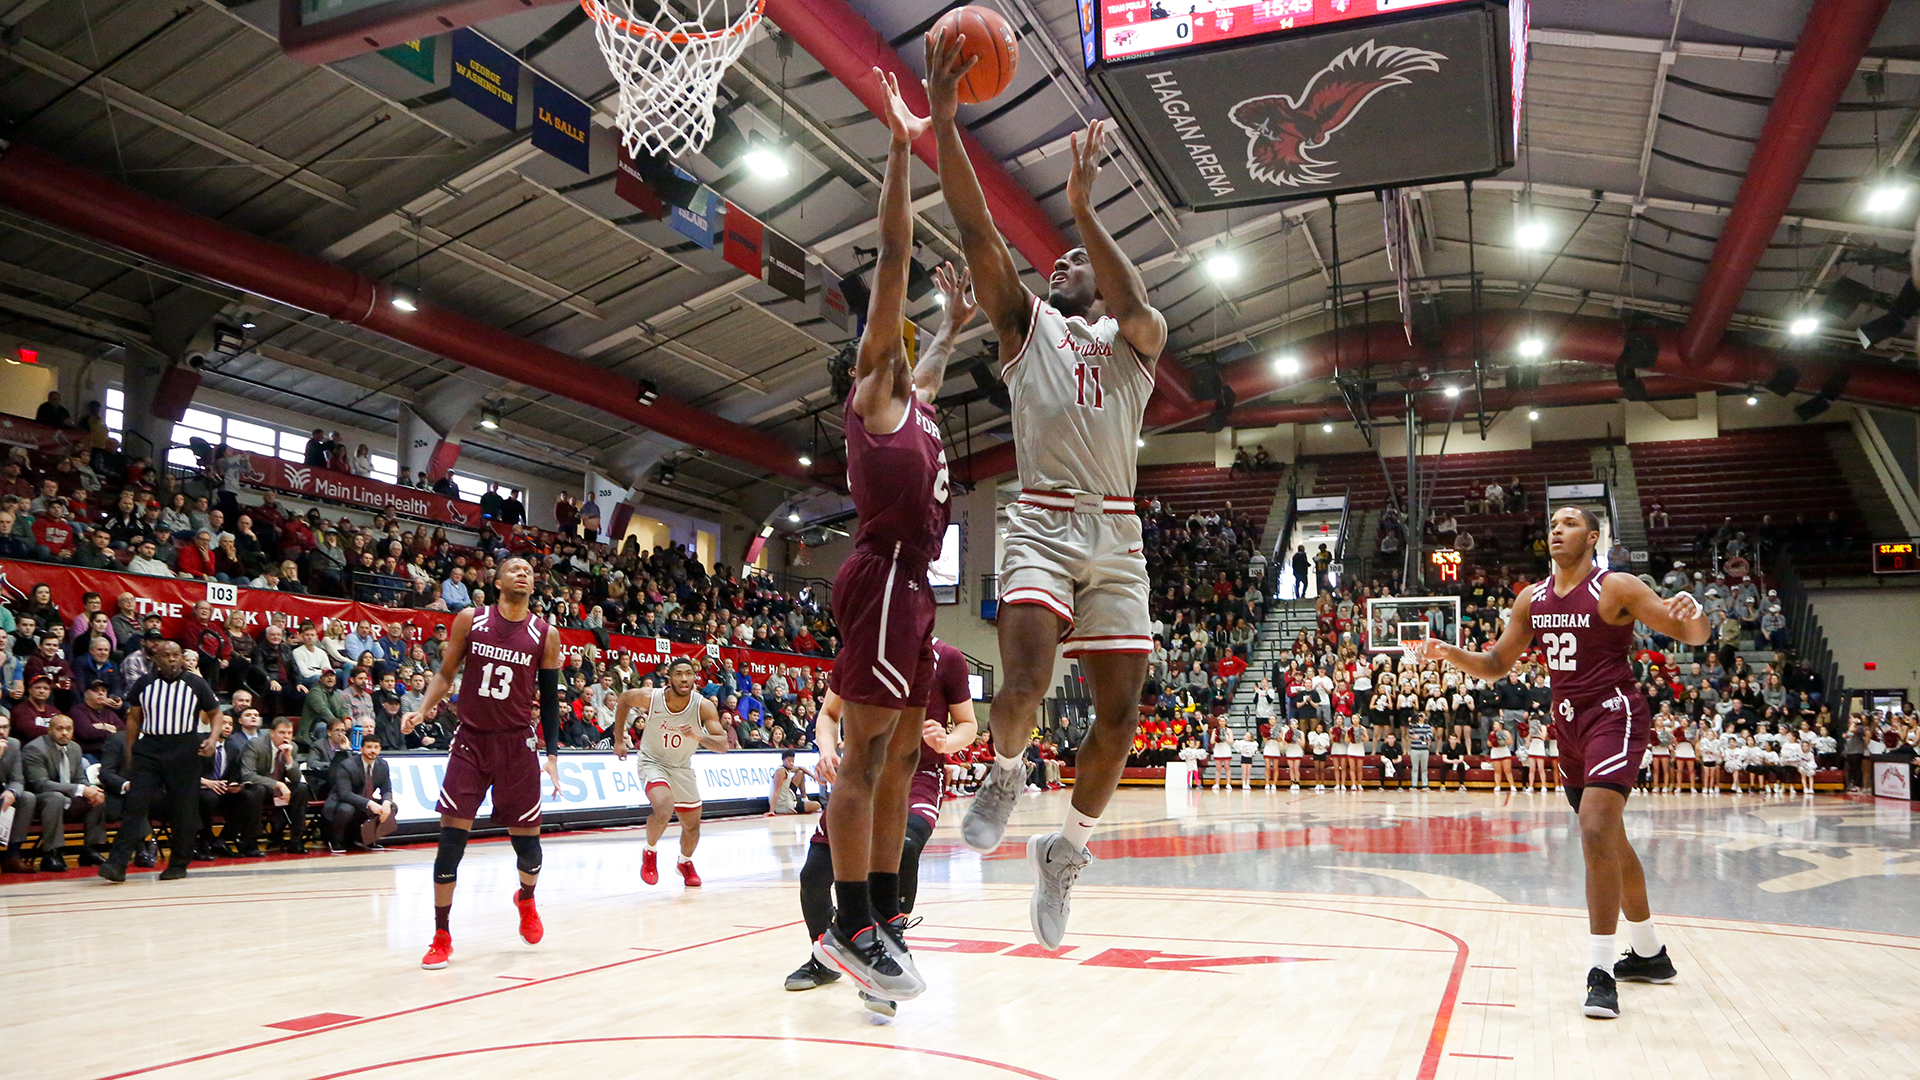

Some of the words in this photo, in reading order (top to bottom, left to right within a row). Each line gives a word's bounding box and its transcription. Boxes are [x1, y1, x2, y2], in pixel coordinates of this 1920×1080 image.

[1107, 4, 1126, 14] TEAM
[1125, 0, 1147, 11] FOULS
[1262, 0, 1312, 17] 15:45
[1126, 11, 1134, 23] 1
[1220, 19, 1230, 31] 4
[1280, 17, 1294, 29] 14
[1176, 23, 1189, 38] 0
[1106, 51, 1155, 63] DAKTRONICS
[469, 59, 501, 85] GEORGE
[455, 61, 513, 105] WASHINGTON
[538, 107, 552, 125] LA
[554, 116, 585, 144] SALLE
[1145, 70, 1206, 141] HAGAN
[1184, 143, 1236, 198] ARENA
[1073, 362, 1105, 410] 11
[315, 477, 351, 500] Main
[352, 486, 383, 506] Line
[384, 492, 429, 516] Health
[599, 489, 612, 497] 205
[1432, 551, 1462, 564] 15:45
[1632, 552, 1646, 560] 109
[1894, 556, 1903, 568] 0
[1440, 563, 1459, 581] 14
[210, 585, 233, 602] 103
[134, 597, 183, 618] THE
[194, 603, 259, 625] AK
[265, 610, 310, 629] IL
[322, 616, 382, 637] NEVR
[1531, 613, 1591, 629] FORDHAM
[657, 640, 669, 650] 103
[707, 646, 719, 656] 104
[1542, 632, 1577, 671] 22
[471, 641, 533, 667] FORDHAM
[606, 650, 619, 660] TO
[628, 650, 661, 664] AGAN
[750, 662, 766, 674] THE
[478, 662, 514, 700] 13
[662, 733, 682, 749] 10
[705, 767, 776, 789] INSURANC
